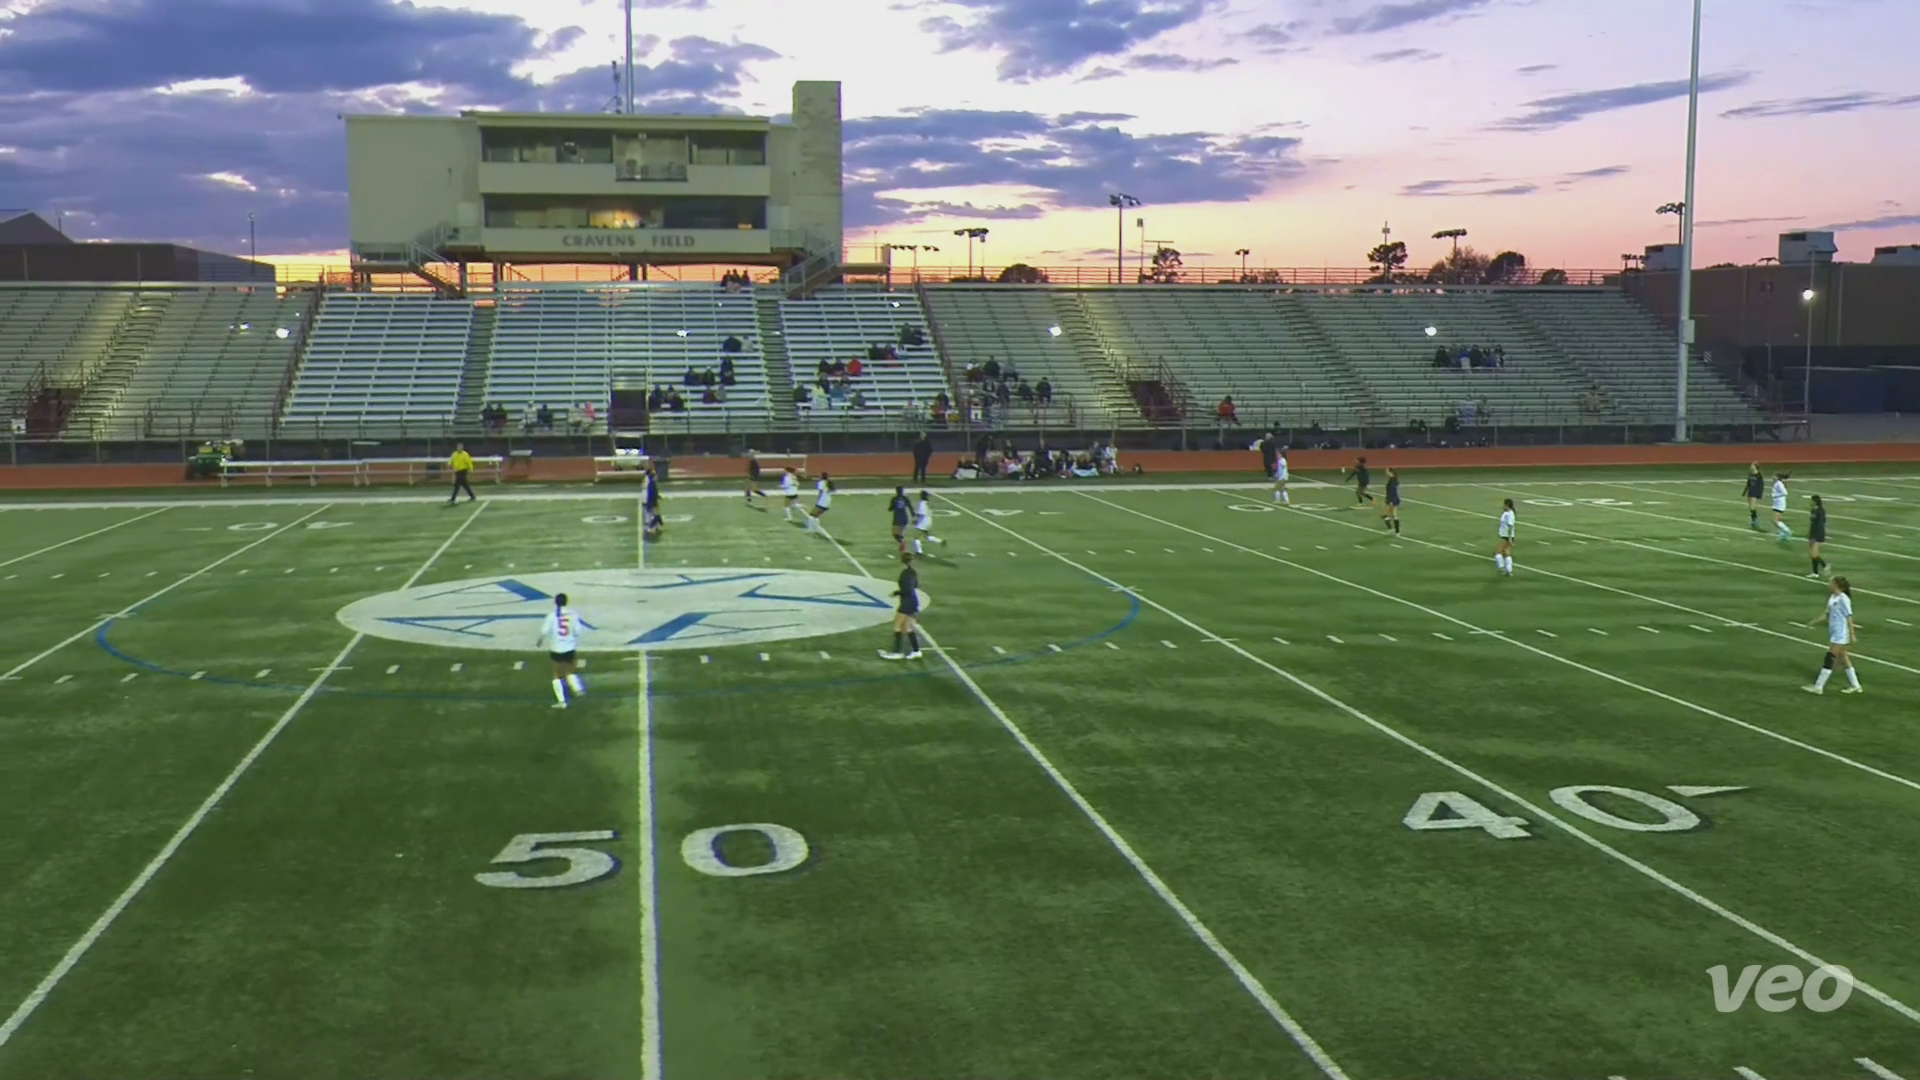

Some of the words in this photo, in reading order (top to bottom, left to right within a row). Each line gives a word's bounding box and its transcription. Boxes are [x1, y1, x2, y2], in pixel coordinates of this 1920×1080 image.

[562, 234, 636, 248] CRAVENS
[652, 235, 695, 248] FIELD
[558, 618, 569, 637] 5
